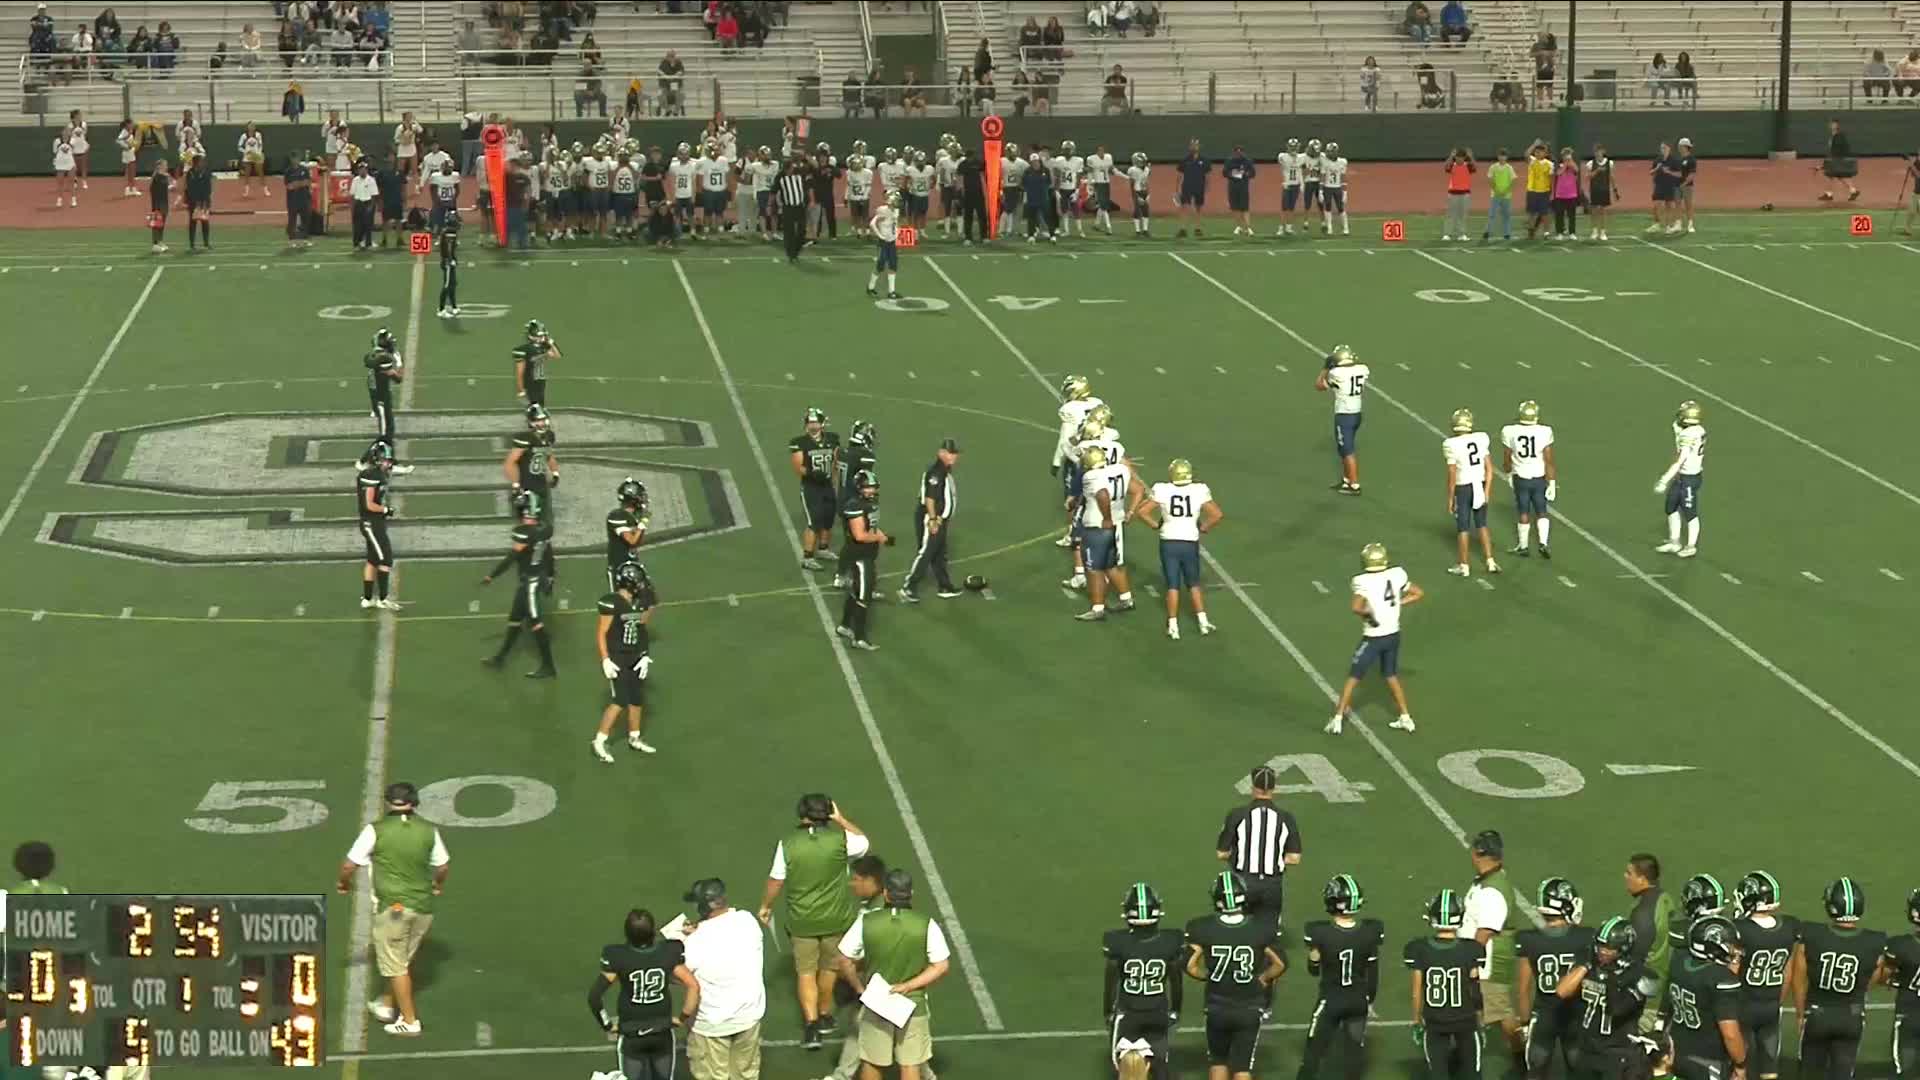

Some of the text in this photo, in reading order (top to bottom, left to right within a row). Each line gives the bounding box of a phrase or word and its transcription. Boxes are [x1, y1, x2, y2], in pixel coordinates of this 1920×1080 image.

[1384, 223, 1401, 238] 30
[1854, 216, 1870, 232] 20
[412, 236, 429, 251] 50
[1349, 374, 1364, 397] 15
[1466, 442, 1481, 466] 2
[1517, 435, 1537, 459] 31
[1108, 474, 1125, 501] 77
[1169, 495, 1194, 518] 61
[1382, 578, 1396, 607] 4
[1123, 958, 1167, 996] 32
[1209, 945, 1255, 984] 73
[1338, 948, 1354, 987] 1
[1745, 948, 1790, 987] 82
[1819, 951, 1859, 994] 13
[629, 968, 666, 1004] 12
[1426, 966, 1463, 1007] 81
[1582, 988, 1613, 1036] 71
